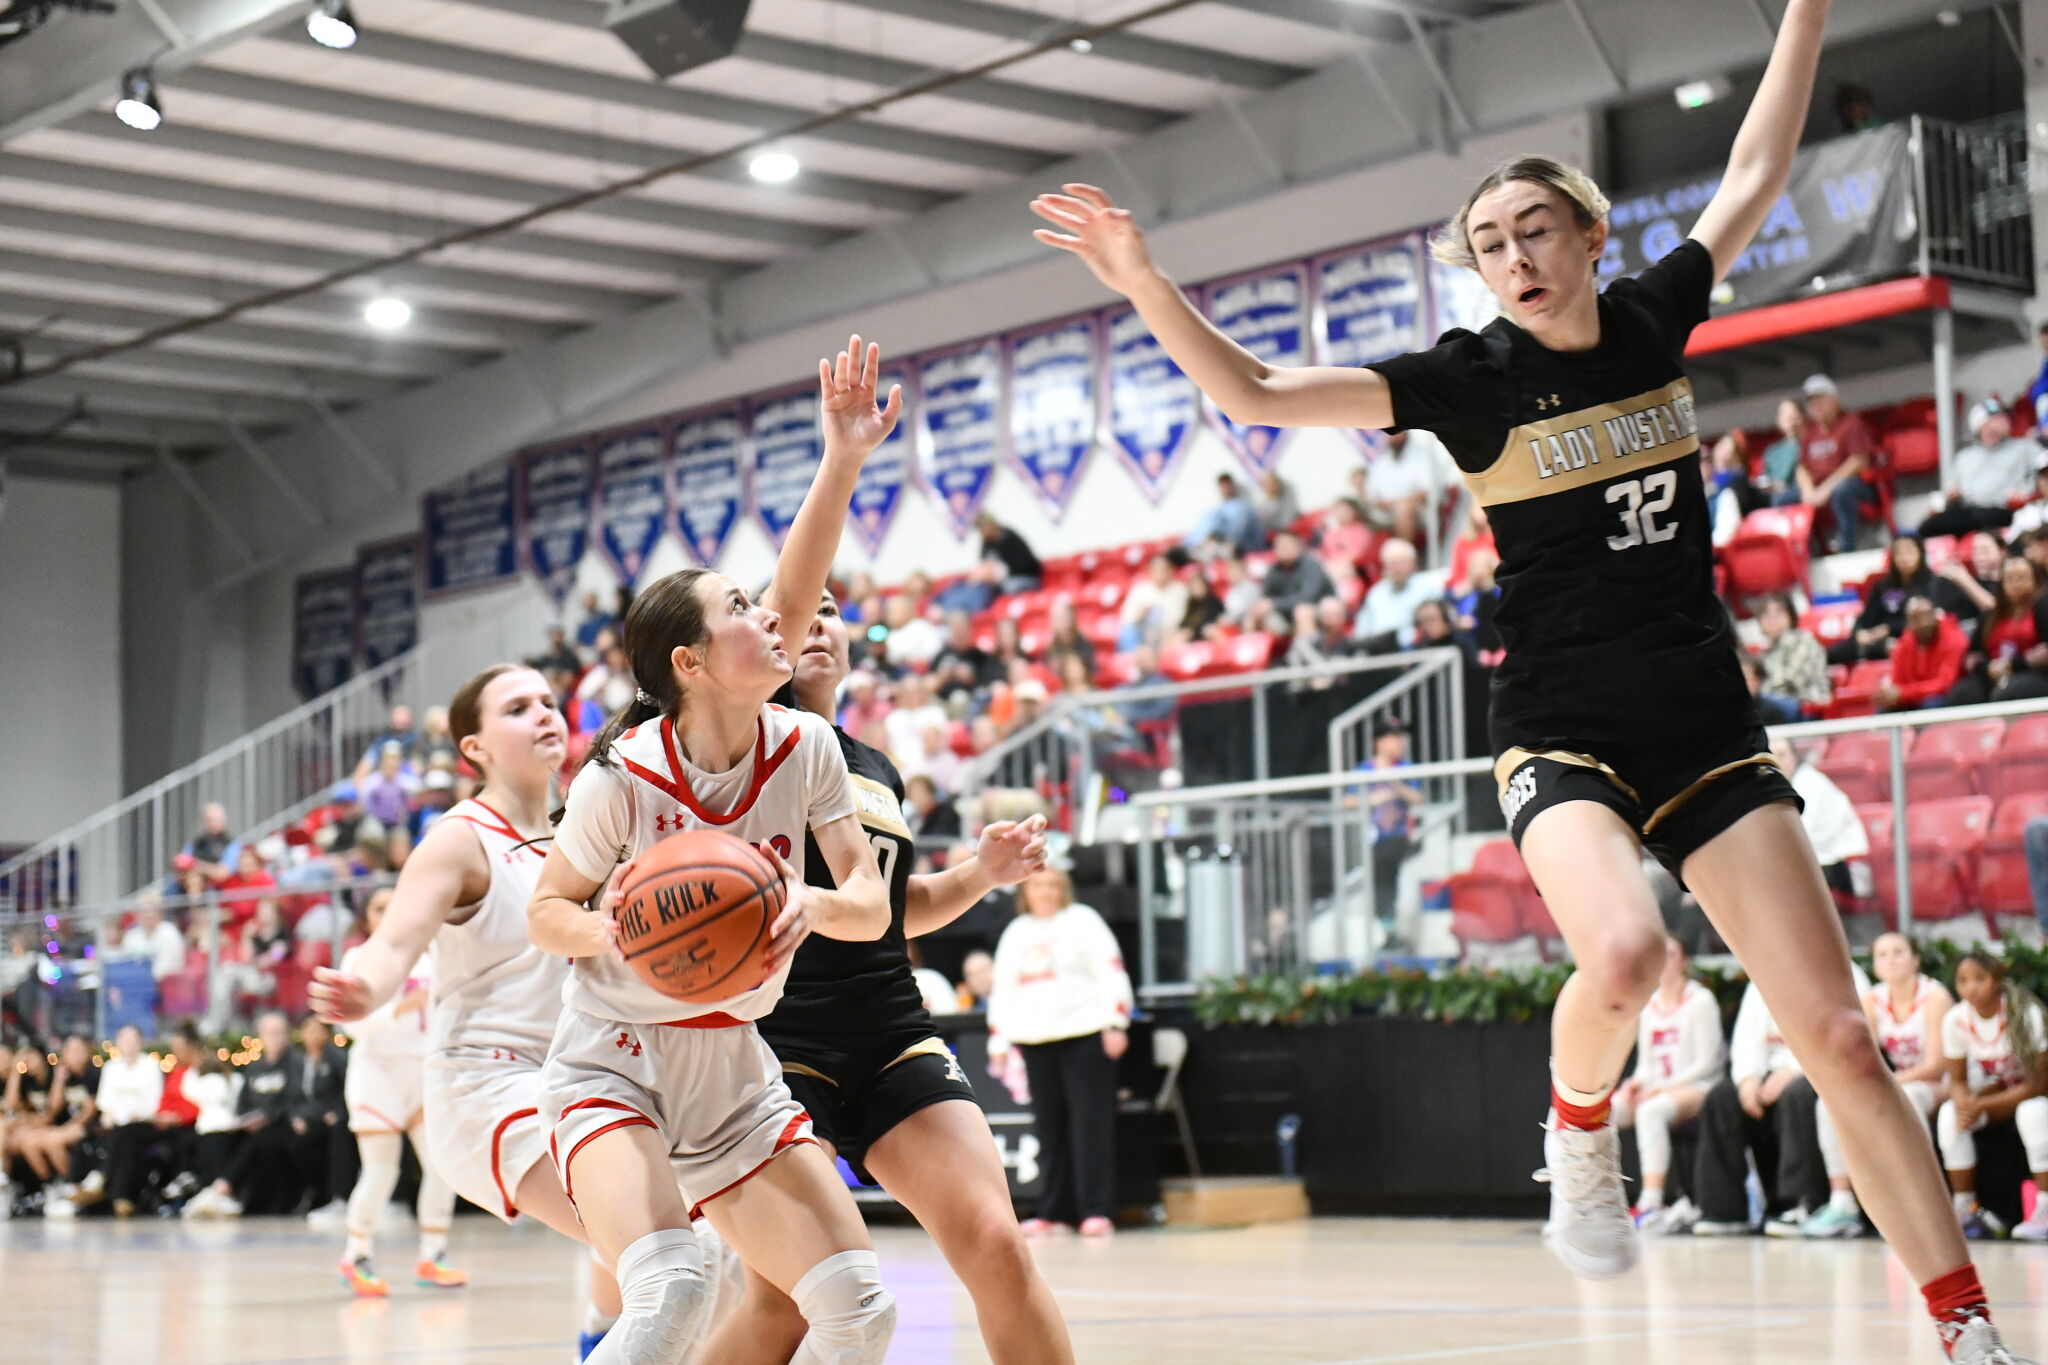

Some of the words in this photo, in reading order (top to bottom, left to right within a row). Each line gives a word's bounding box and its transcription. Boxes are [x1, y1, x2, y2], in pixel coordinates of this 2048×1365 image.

[1609, 177, 1722, 228] WELCOM
[1528, 423, 1600, 479] LADY
[1604, 469, 1680, 551] 32
[654, 878, 720, 927] ROCK
